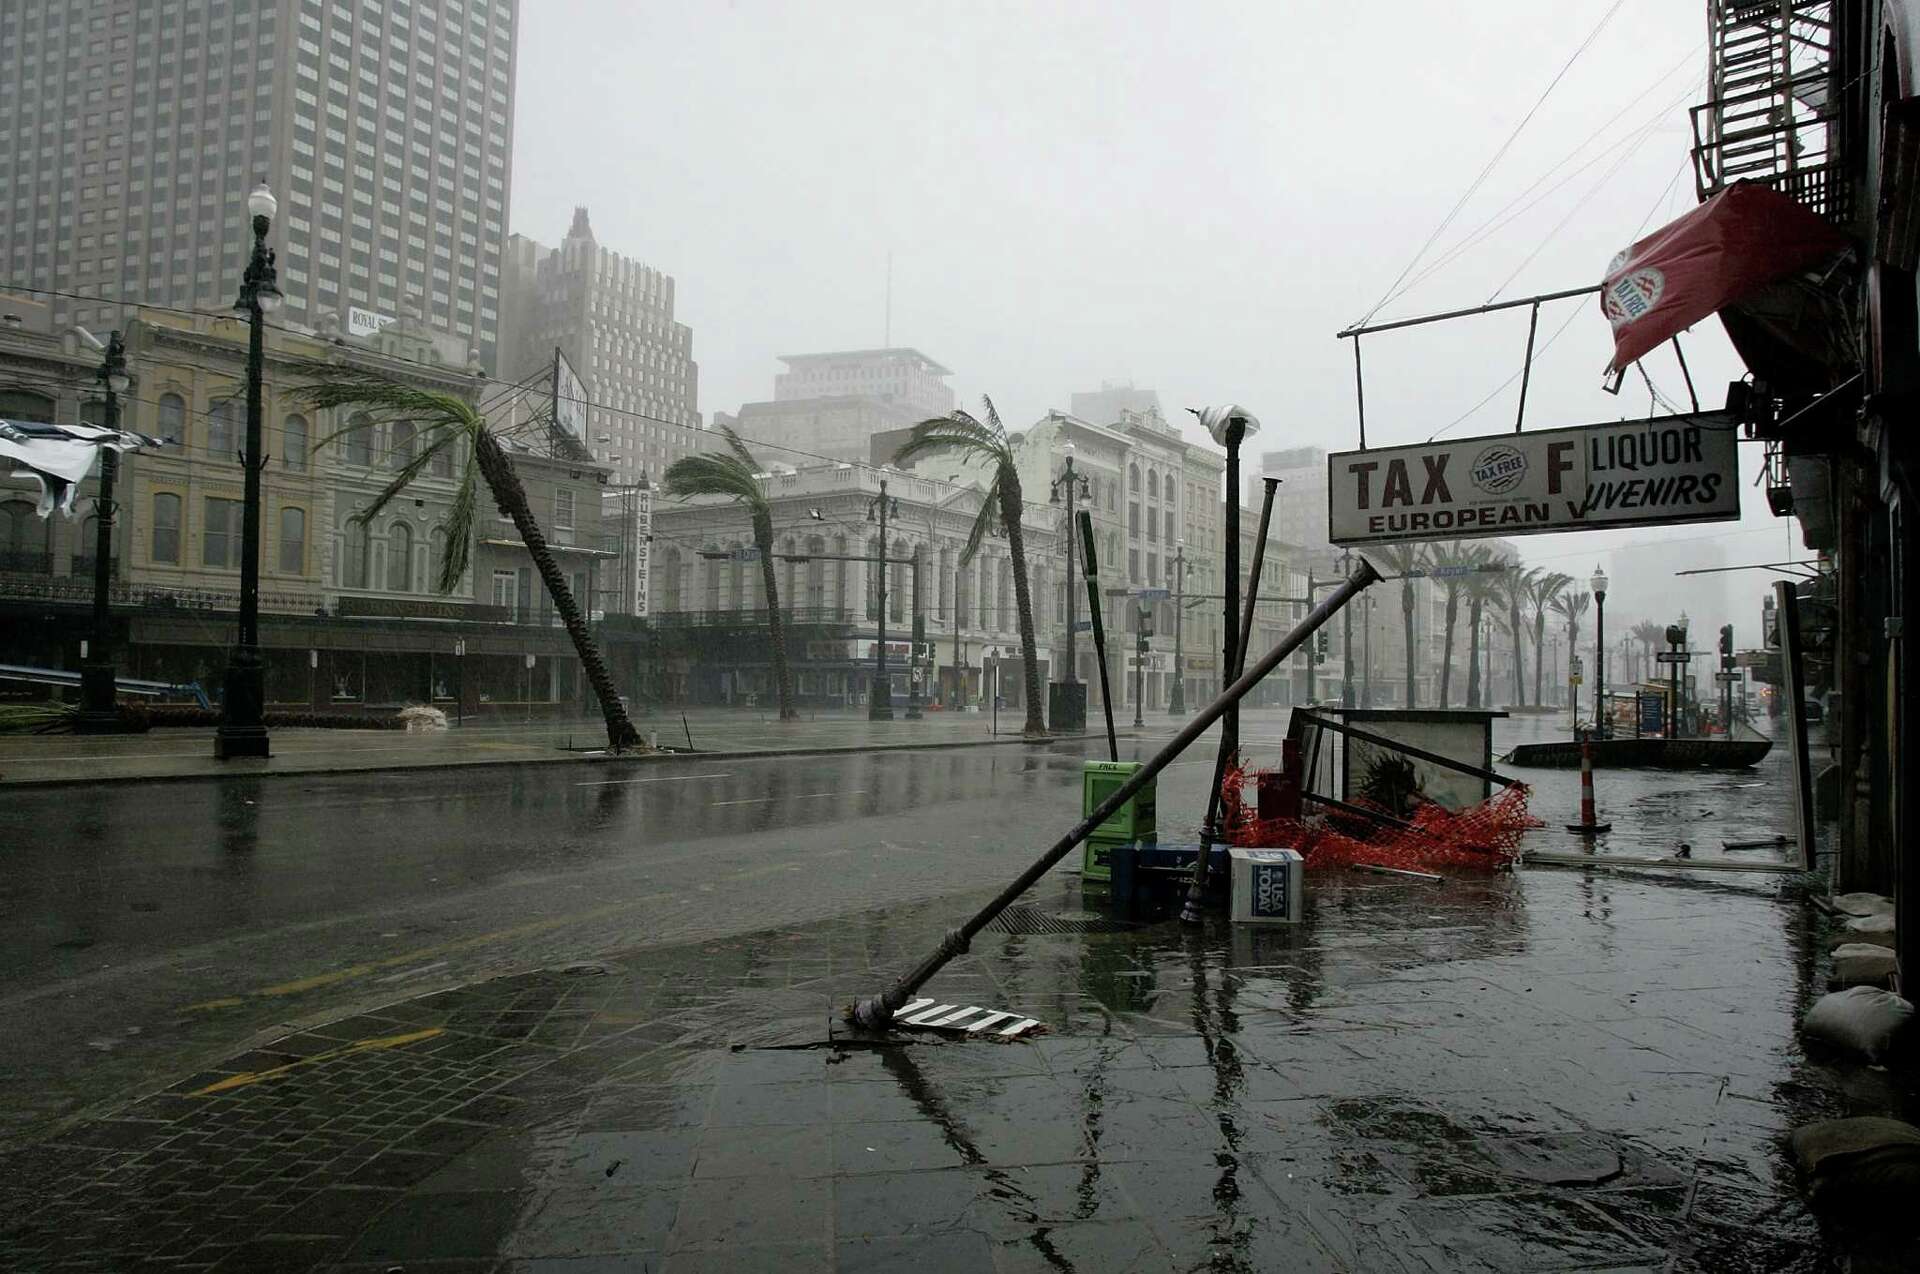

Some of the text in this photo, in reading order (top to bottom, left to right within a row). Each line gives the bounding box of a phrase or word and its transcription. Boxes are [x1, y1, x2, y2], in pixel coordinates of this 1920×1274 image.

[1614, 278, 1648, 317] TAX FREE
[352, 310, 377, 330] ROYAL
[1592, 427, 1703, 471] LIQUOR
[1348, 453, 1453, 510] TAX
[1474, 456, 1524, 482] TAX FREE
[1368, 502, 1550, 533] EUROPEAN
[638, 492, 649, 613] RUBENSTEINS
[1258, 867, 1271, 913] TODAY
[1271, 883, 1284, 912] USA
